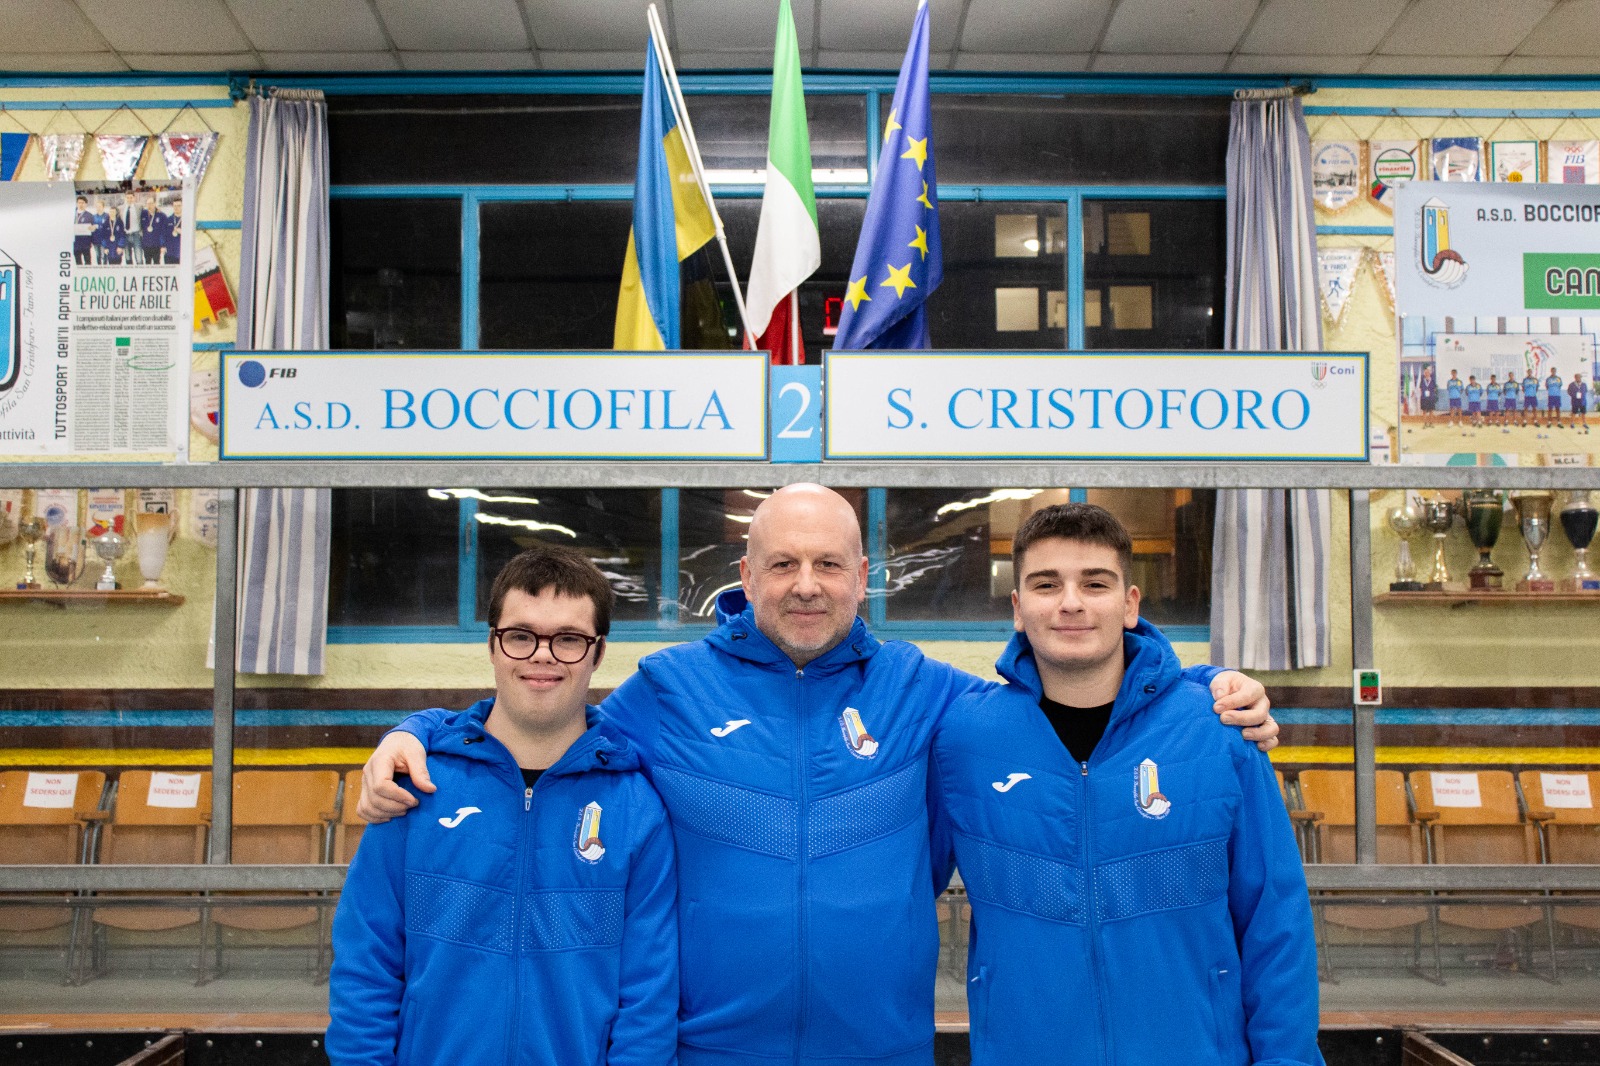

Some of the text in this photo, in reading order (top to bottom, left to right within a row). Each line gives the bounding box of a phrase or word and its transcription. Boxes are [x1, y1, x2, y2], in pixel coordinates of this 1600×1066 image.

[1565, 154, 1585, 164] FIB
[1477, 208, 1517, 221] A.S.D.
[59, 251, 71, 277] 2019
[25, 270, 34, 290] 1969
[74, 276, 179, 292] LOANO, LA FESTA
[58, 283, 71, 320] Aprile
[113, 294, 136, 309] CHE
[140, 294, 172, 309] ABILE
[23, 328, 39, 377] Cristoforo
[269, 368, 297, 378] FIB
[1330, 365, 1355, 375] Coni
[15, 378, 31, 400] San
[55, 365, 68, 440] TUTTOSPORT
[254, 388, 735, 430] A.S.D. BOCCIOFILA
[777, 382, 814, 438] 2
[887, 388, 1311, 430] S. CRISTOFORO
[153, 787, 181, 795] SEDERSI
